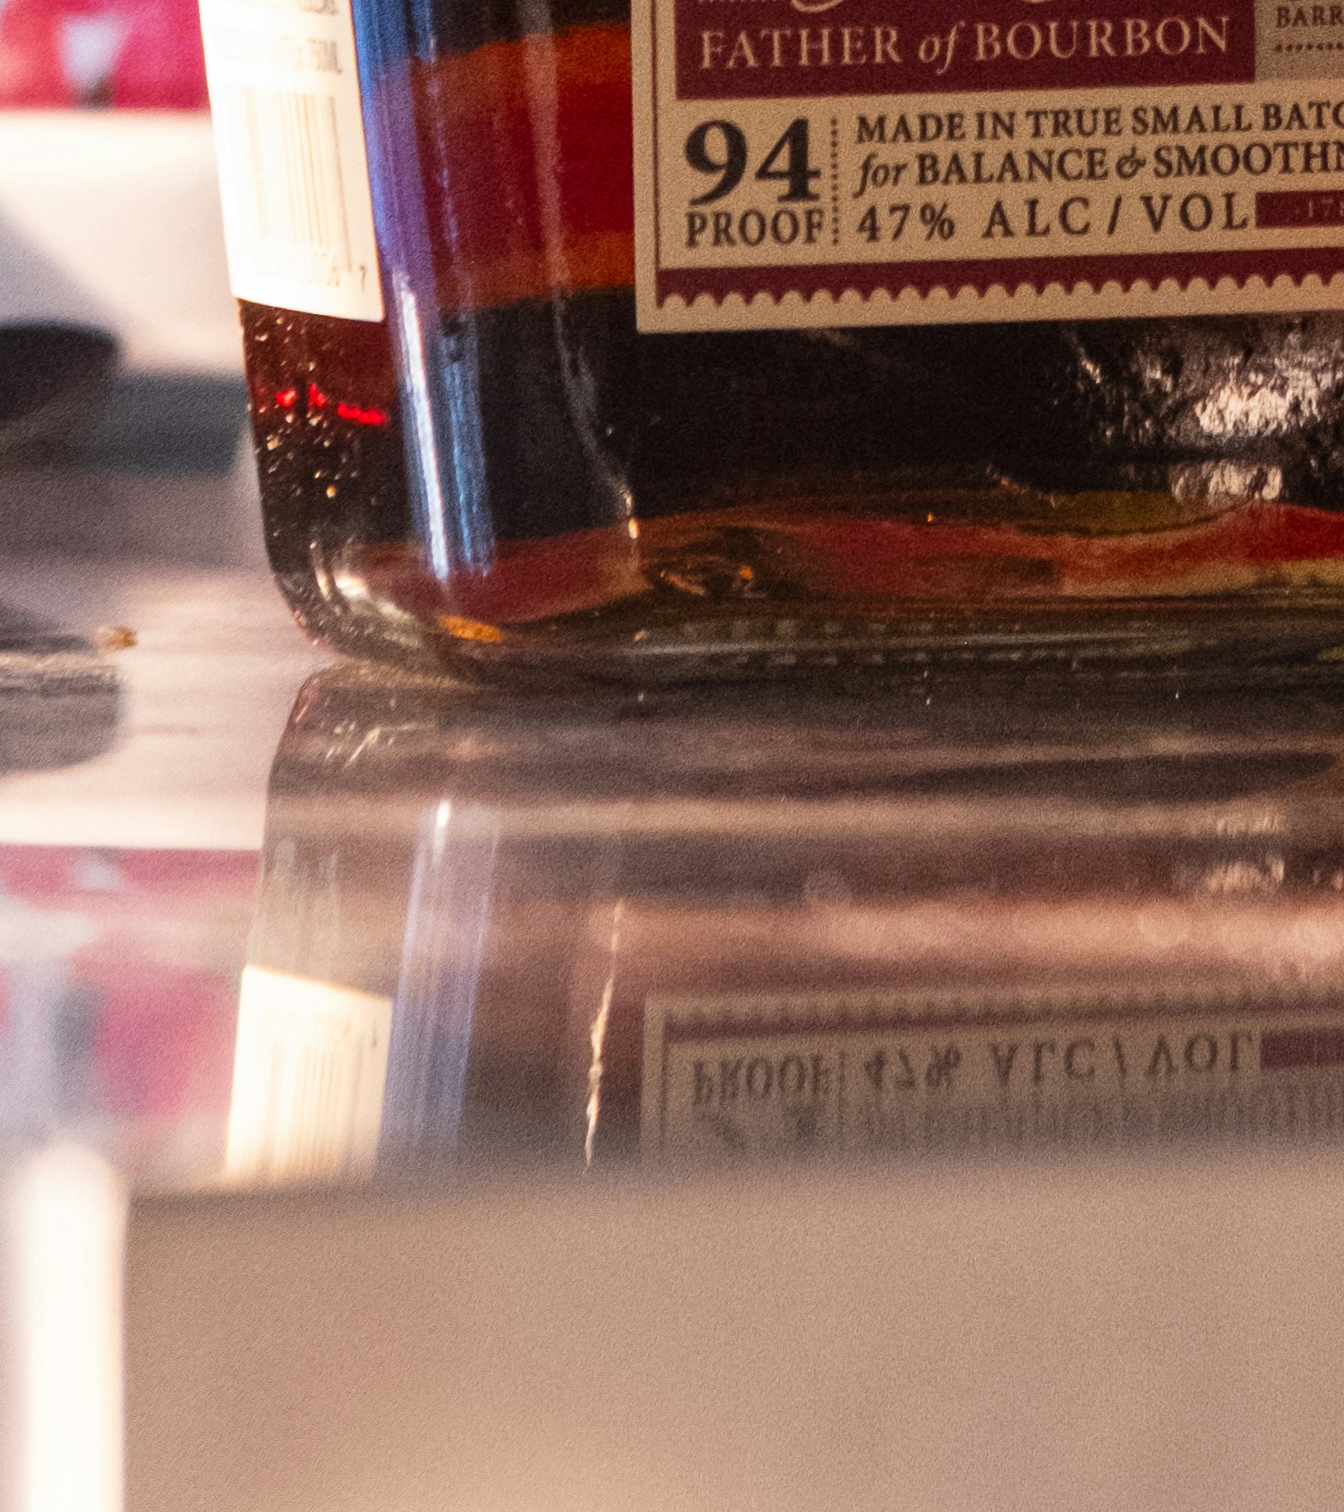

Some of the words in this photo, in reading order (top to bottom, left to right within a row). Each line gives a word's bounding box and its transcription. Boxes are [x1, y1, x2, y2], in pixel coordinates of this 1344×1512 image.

[699, 26, 901, 70] FATHER
[918, 19, 967, 74] of
[974, 16, 1230, 62] BOURBON
[855, 108, 968, 146] MADE
[974, 108, 1018, 142] IN
[1026, 106, 1123, 138] TRUE
[1130, 102, 1254, 136] SMALL
[684, 116, 822, 208] 94
[854, 151, 910, 198] for
[916, 145, 1109, 186] BALANCE
[1115, 147, 1148, 181] &
[685, 208, 825, 250] PROOF
[855, 200, 957, 244] 47%
[981, 196, 1090, 238] ALC
[1106, 194, 1124, 235] /
[1138, 189, 1249, 233] VOL
